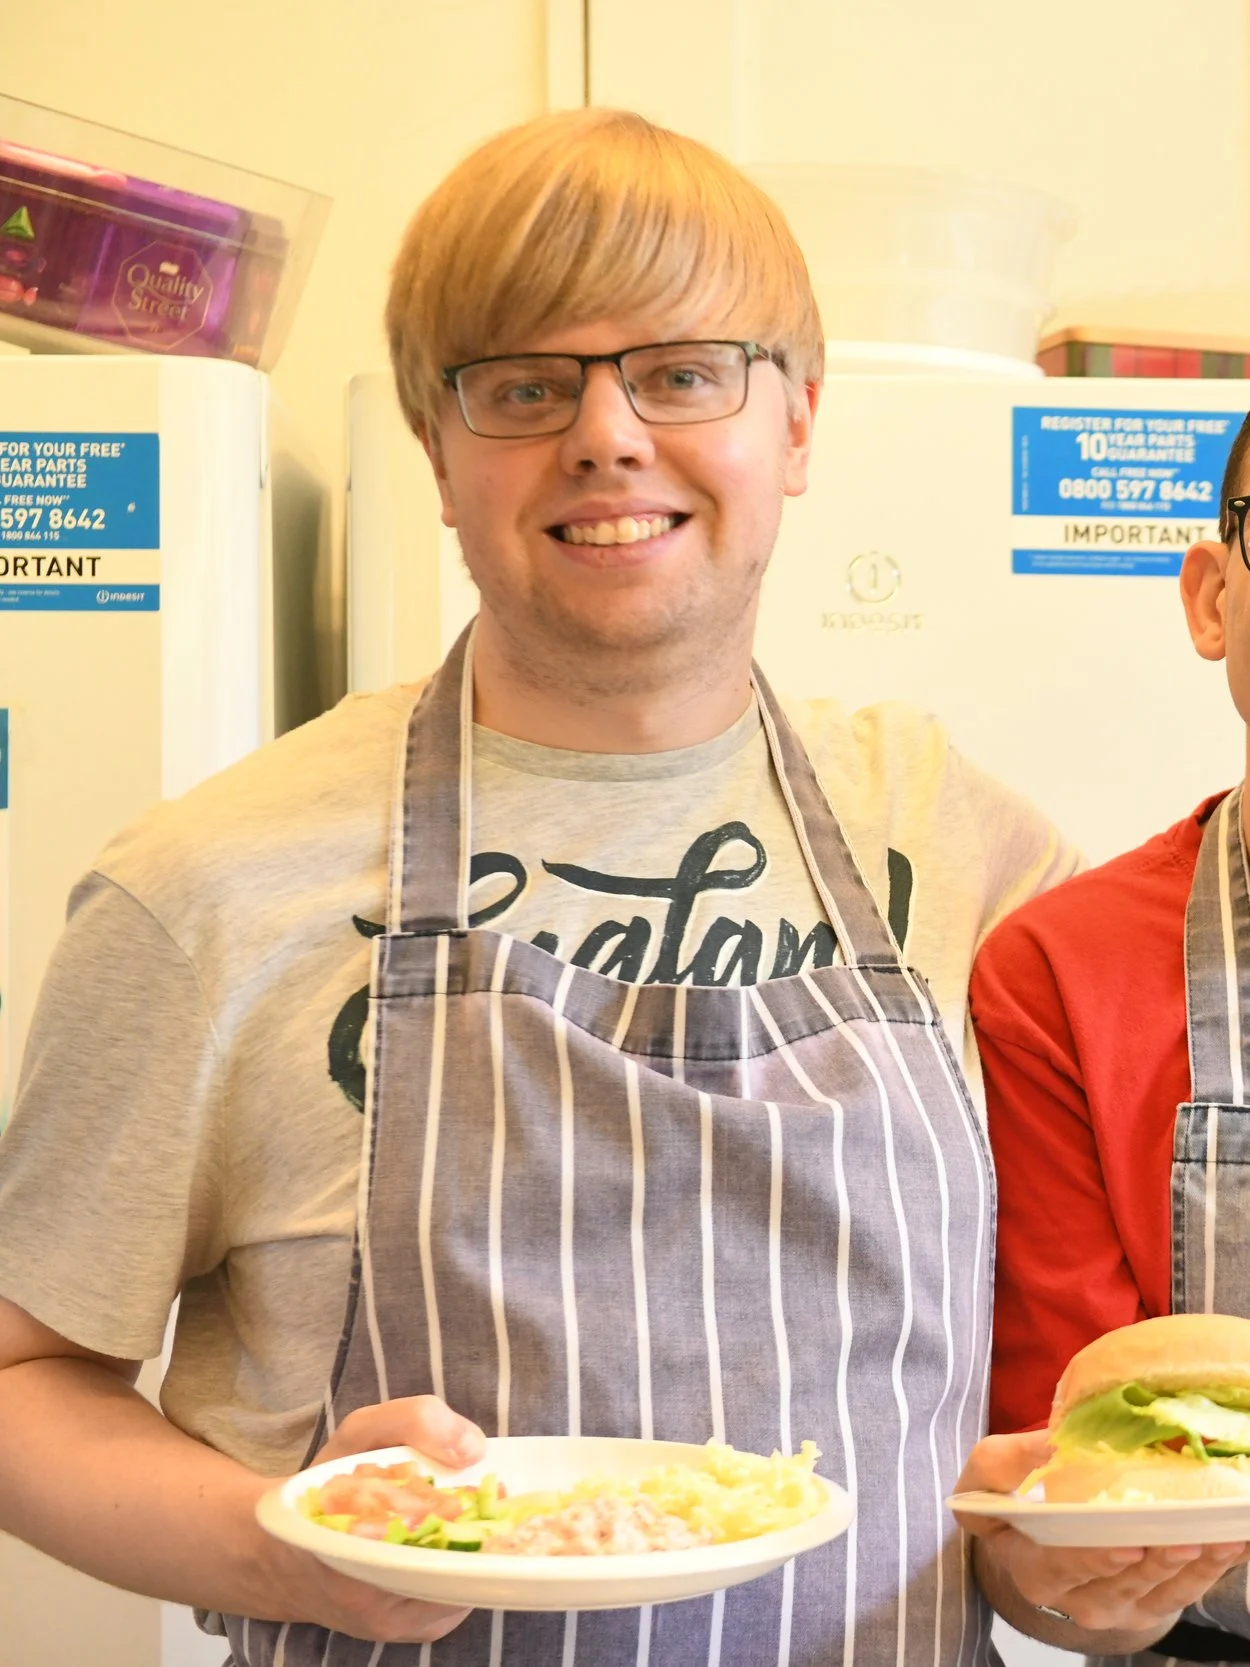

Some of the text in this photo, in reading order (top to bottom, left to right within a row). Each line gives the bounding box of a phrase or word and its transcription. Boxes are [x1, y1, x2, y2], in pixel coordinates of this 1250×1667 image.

[127, 264, 205, 304] Quality
[128, 287, 189, 320] Street
[1040, 416, 1112, 431] REGISTER
[1114, 417, 1144, 432] FOR
[1146, 418, 1185, 433] YOUR
[0, 442, 30, 456] FOR
[33, 442, 76, 457] YOUR
[1076, 432, 1195, 461] 10 YEAR PARTS
[1107, 447, 1196, 463] GUARANTEE
[36, 458, 87, 473] PARTS
[0, 473, 87, 488] UARANTEE
[1059, 478, 1213, 502] 0800 597 8642
[4, 495, 33, 506] FREE
[0, 508, 106, 530] 597 8642
[2, 531, 23, 541] 1800
[1064, 524, 1207, 545] IMPORTANT
